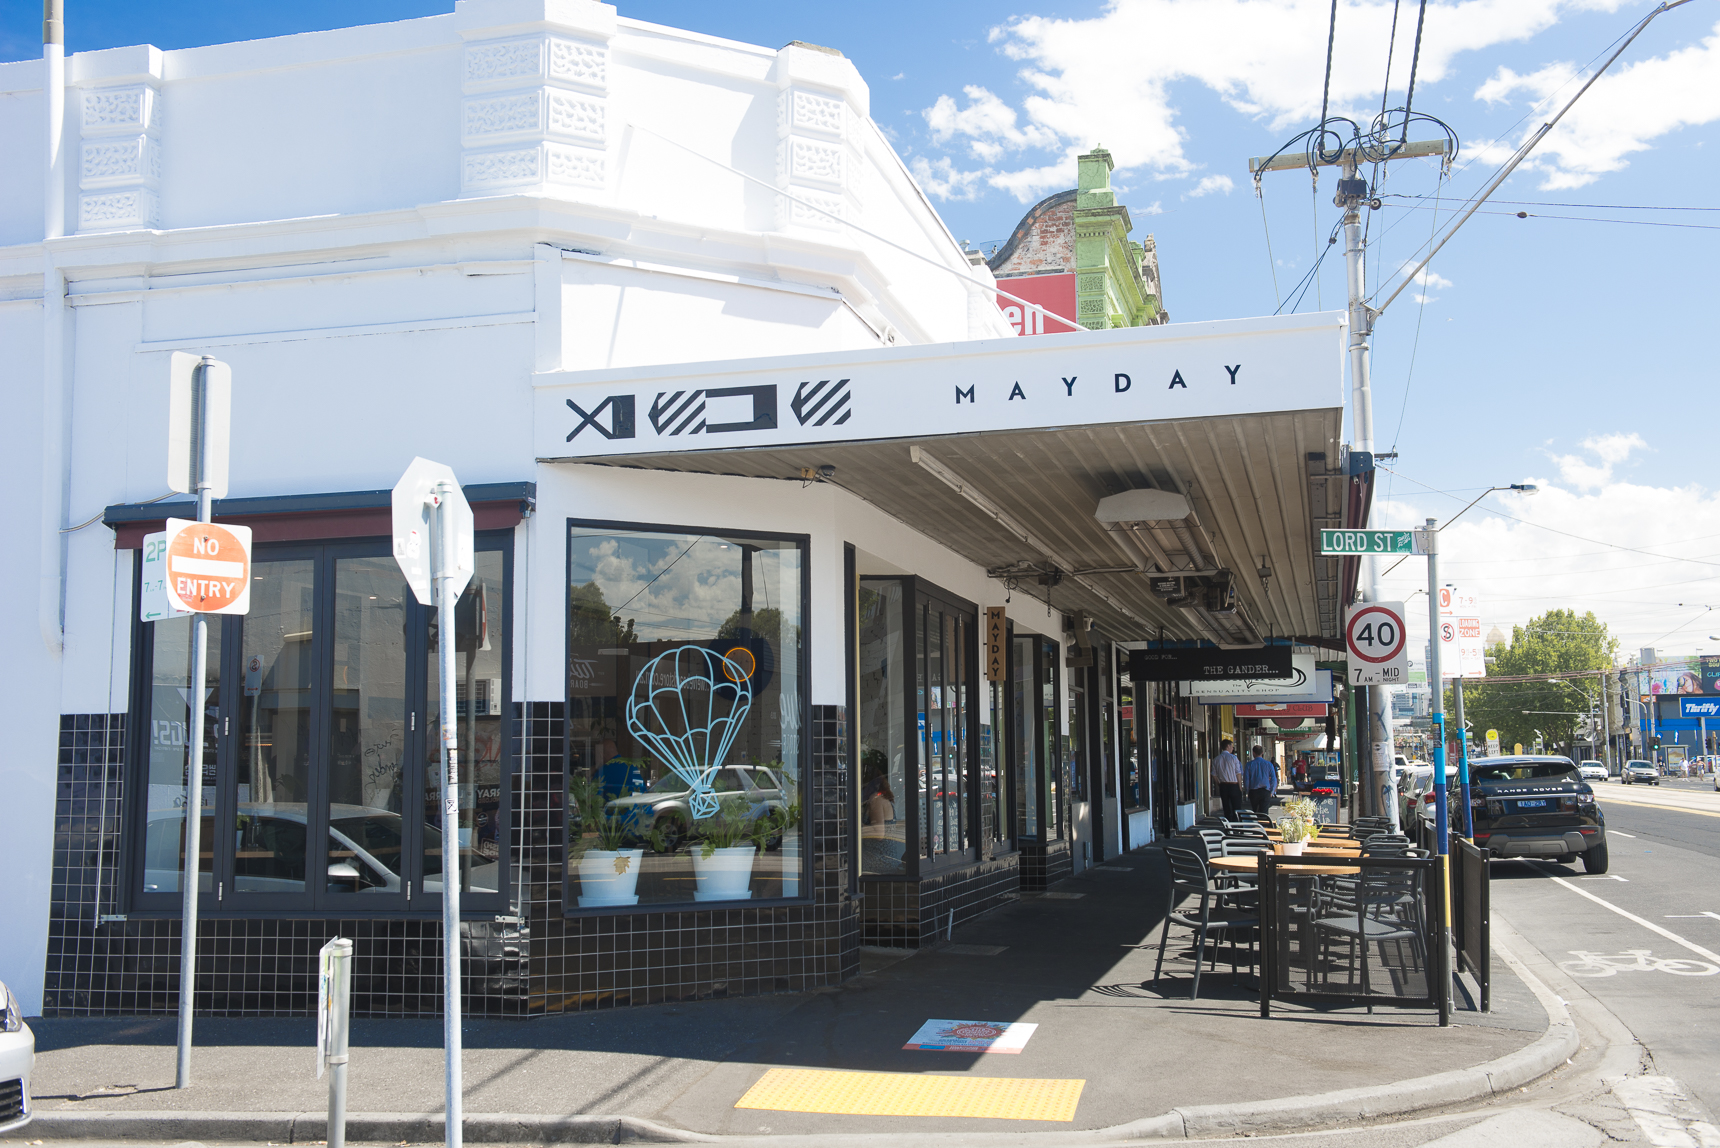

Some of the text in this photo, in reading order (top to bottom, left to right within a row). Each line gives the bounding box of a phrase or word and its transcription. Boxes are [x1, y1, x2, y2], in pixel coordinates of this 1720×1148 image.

[956, 364, 1242, 405] MAYDAY
[145, 540, 167, 562] 2P
[193, 537, 220, 556] NO
[1322, 532, 1394, 551] LORD ST
[176, 576, 235, 599] ENTRY
[1459, 619, 1480, 628] LOADING
[1459, 628, 1480, 637] ZONE
[991, 611, 1000, 677] MAYDAY
[1356, 622, 1395, 647] 40
[1203, 665, 1279, 675] THE GANDER...
[1354, 668, 1363, 683] 7
[1382, 667, 1400, 677] MID
[1685, 702, 1720, 716] Thrifty
